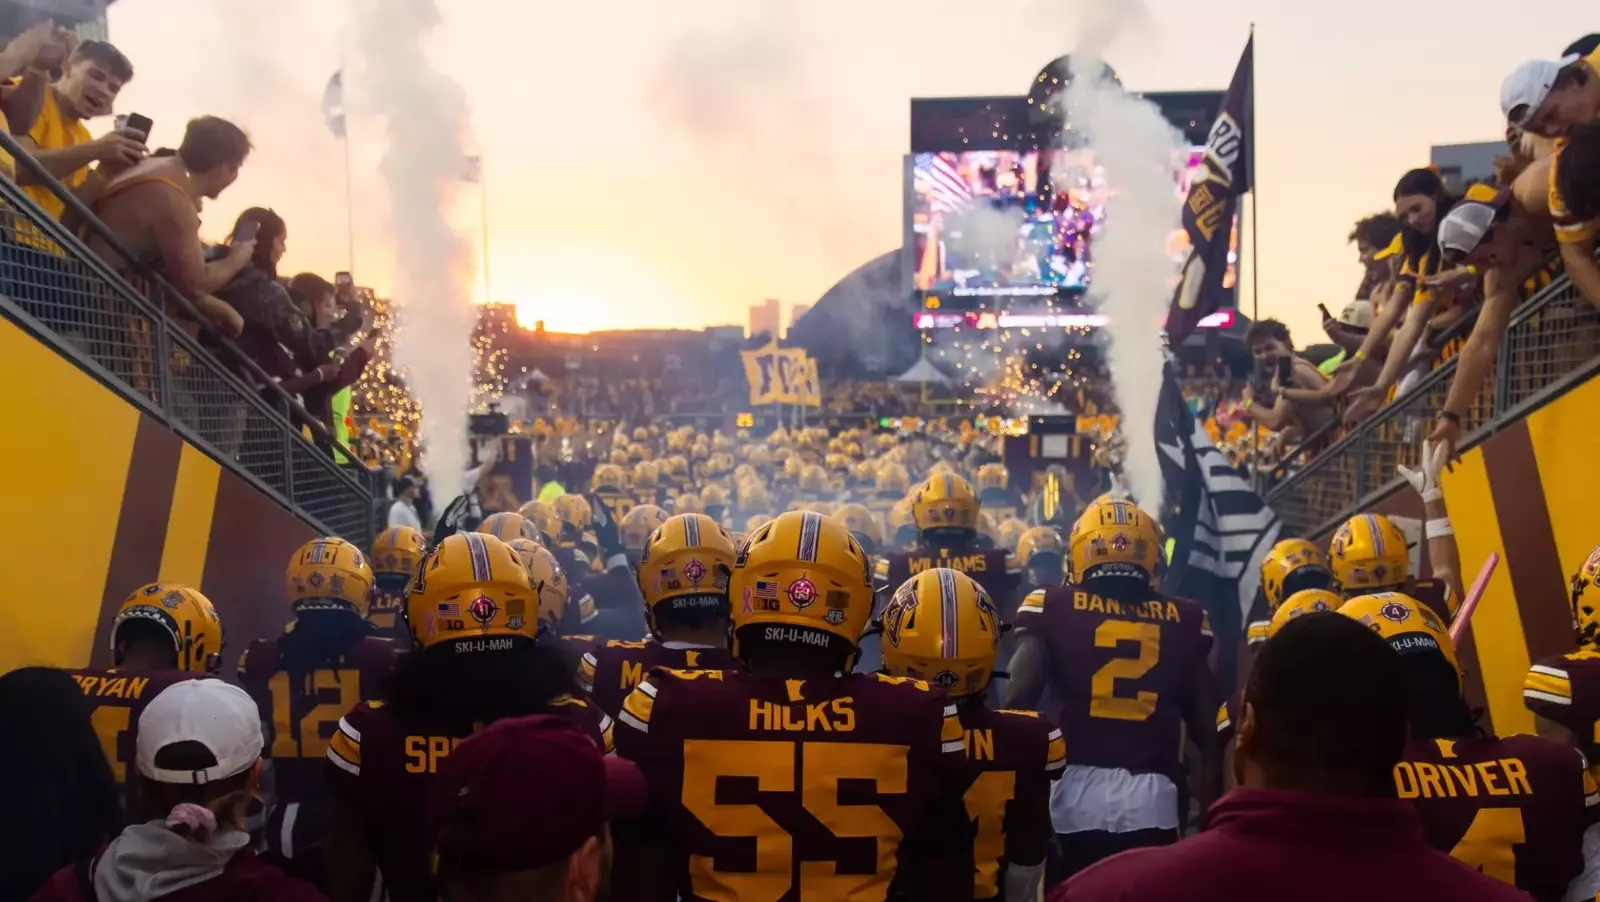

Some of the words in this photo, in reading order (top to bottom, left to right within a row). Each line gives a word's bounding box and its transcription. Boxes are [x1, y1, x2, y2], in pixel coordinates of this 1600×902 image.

[908, 554, 987, 574] WILLIAMS
[671, 595, 719, 609] SKI-U-MAH
[1391, 606, 1400, 617] 4
[455, 638, 513, 653] SKI-U-MAH
[764, 627, 830, 648] SKI-U-MAH
[1090, 618, 1160, 721] 2
[268, 668, 360, 757] 12
[749, 697, 856, 732] HICKS
[1392, 757, 1533, 799] DRIVER
[681, 739, 911, 902] 55
